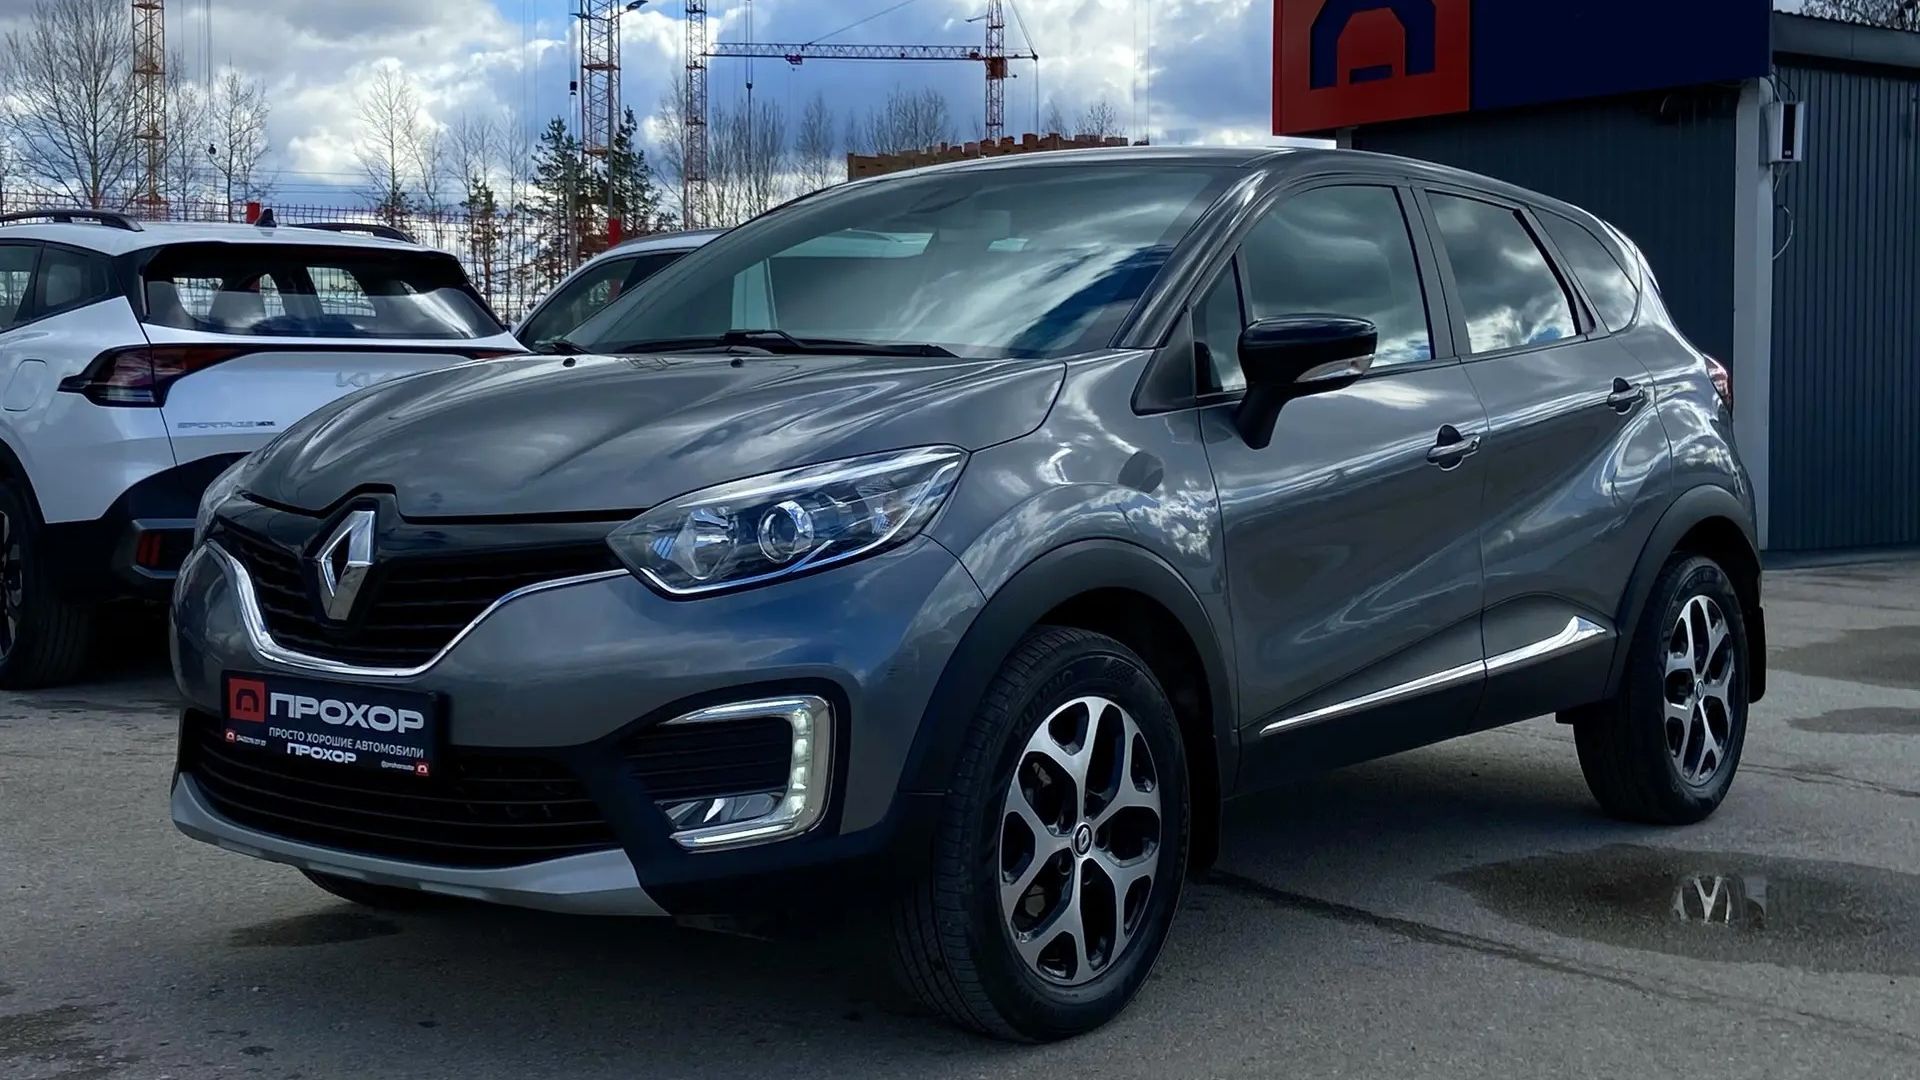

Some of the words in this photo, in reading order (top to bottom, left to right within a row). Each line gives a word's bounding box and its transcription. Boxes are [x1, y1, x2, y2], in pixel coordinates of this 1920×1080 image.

[269, 692, 425, 733] ПРОХОР
[268, 727, 305, 742] ПРОСТО
[306, 733, 353, 748] ХОРОШИЕ
[354, 739, 424, 759] АВТОМОБИЛИ
[286, 742, 357, 764] ПРОХОР
